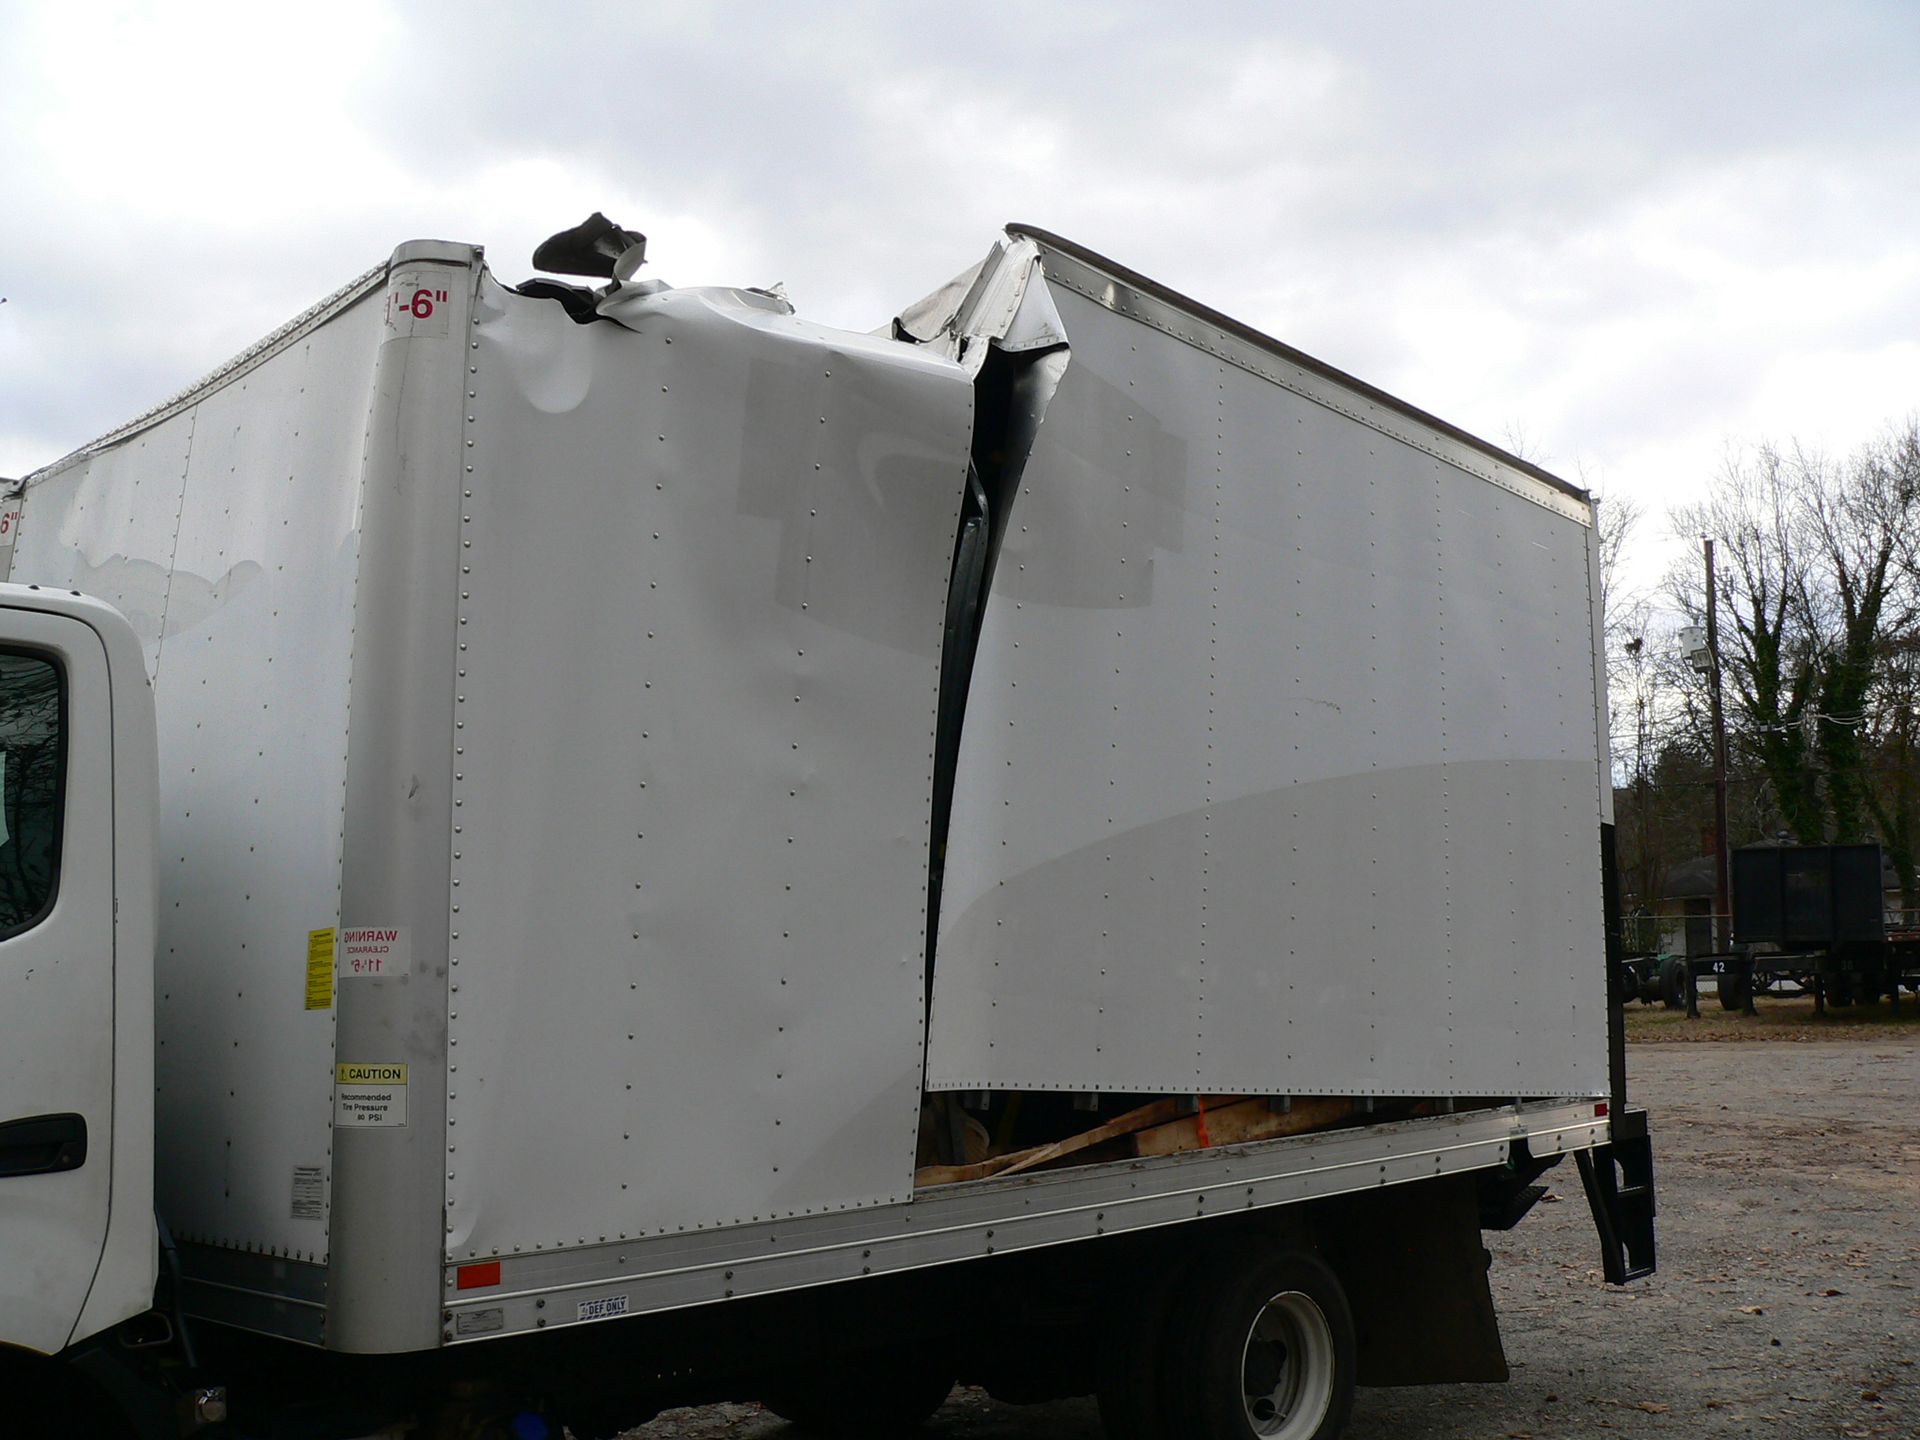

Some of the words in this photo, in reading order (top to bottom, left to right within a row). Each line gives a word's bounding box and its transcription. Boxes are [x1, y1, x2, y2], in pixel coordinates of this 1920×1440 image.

[1712, 961, 1725, 973] 42
[348, 1068, 401, 1080] CAUTION
[354, 1103, 389, 1112] Pressure
[368, 1113, 383, 1121] PSI
[588, 1303, 605, 1315] DEF
[606, 1300, 626, 1312] ONLY
